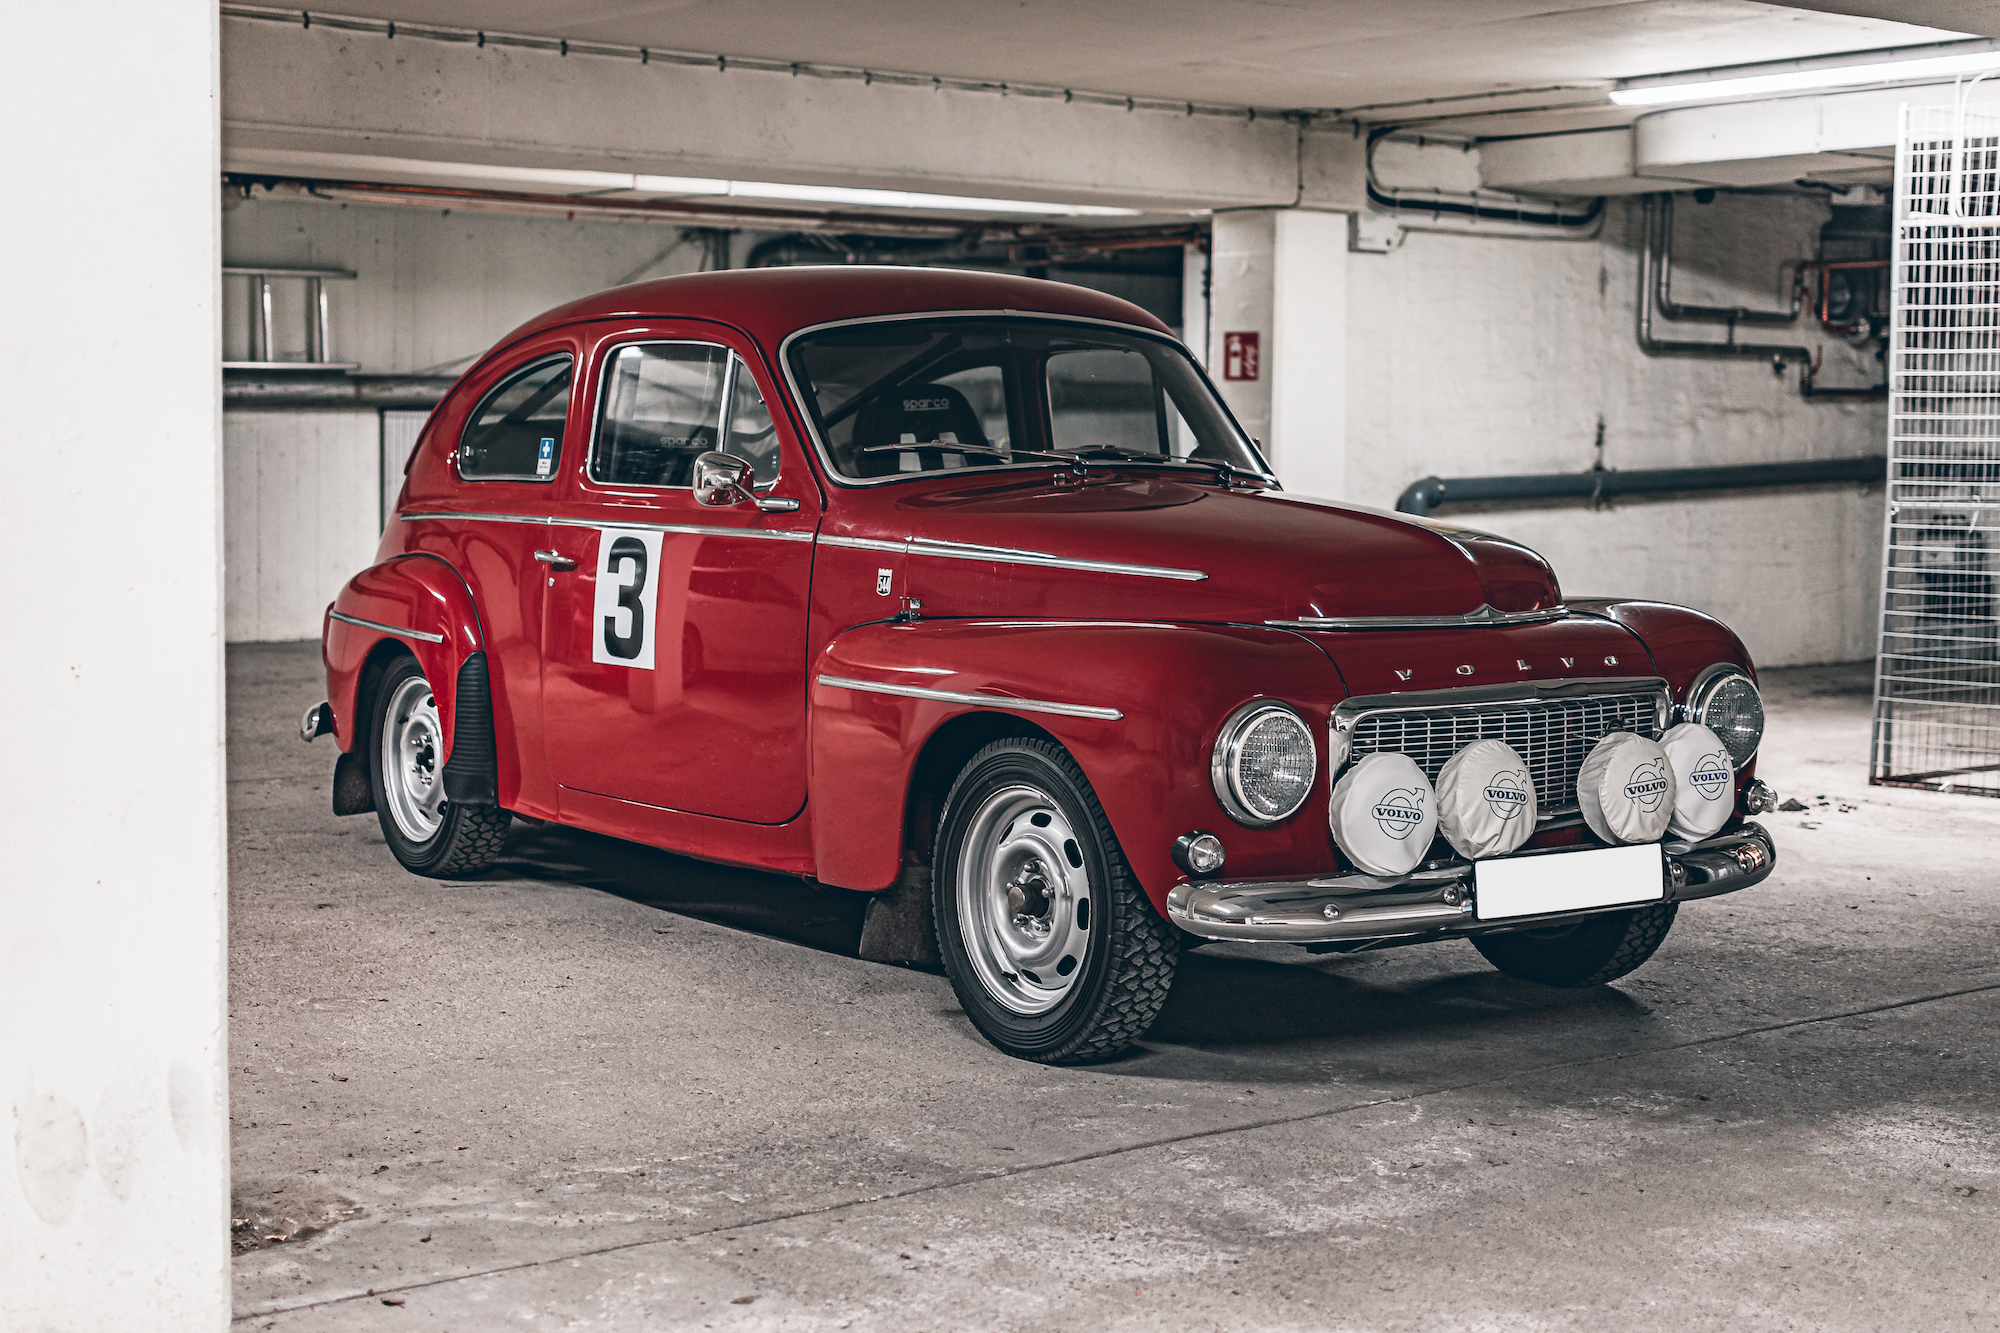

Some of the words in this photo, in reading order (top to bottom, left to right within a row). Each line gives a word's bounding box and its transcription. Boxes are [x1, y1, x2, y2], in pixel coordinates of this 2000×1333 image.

[903, 398, 949, 411] sparco
[660, 437, 708, 448] sparco
[604, 536, 648, 659] 3
[1394, 655, 1619, 681] VOLVO
[1692, 772, 1728, 783] VOLVO
[1628, 781, 1666, 793] VOLVO
[1487, 789, 1527, 802] VOLVO
[1376, 807, 1422, 822] VOLVO
